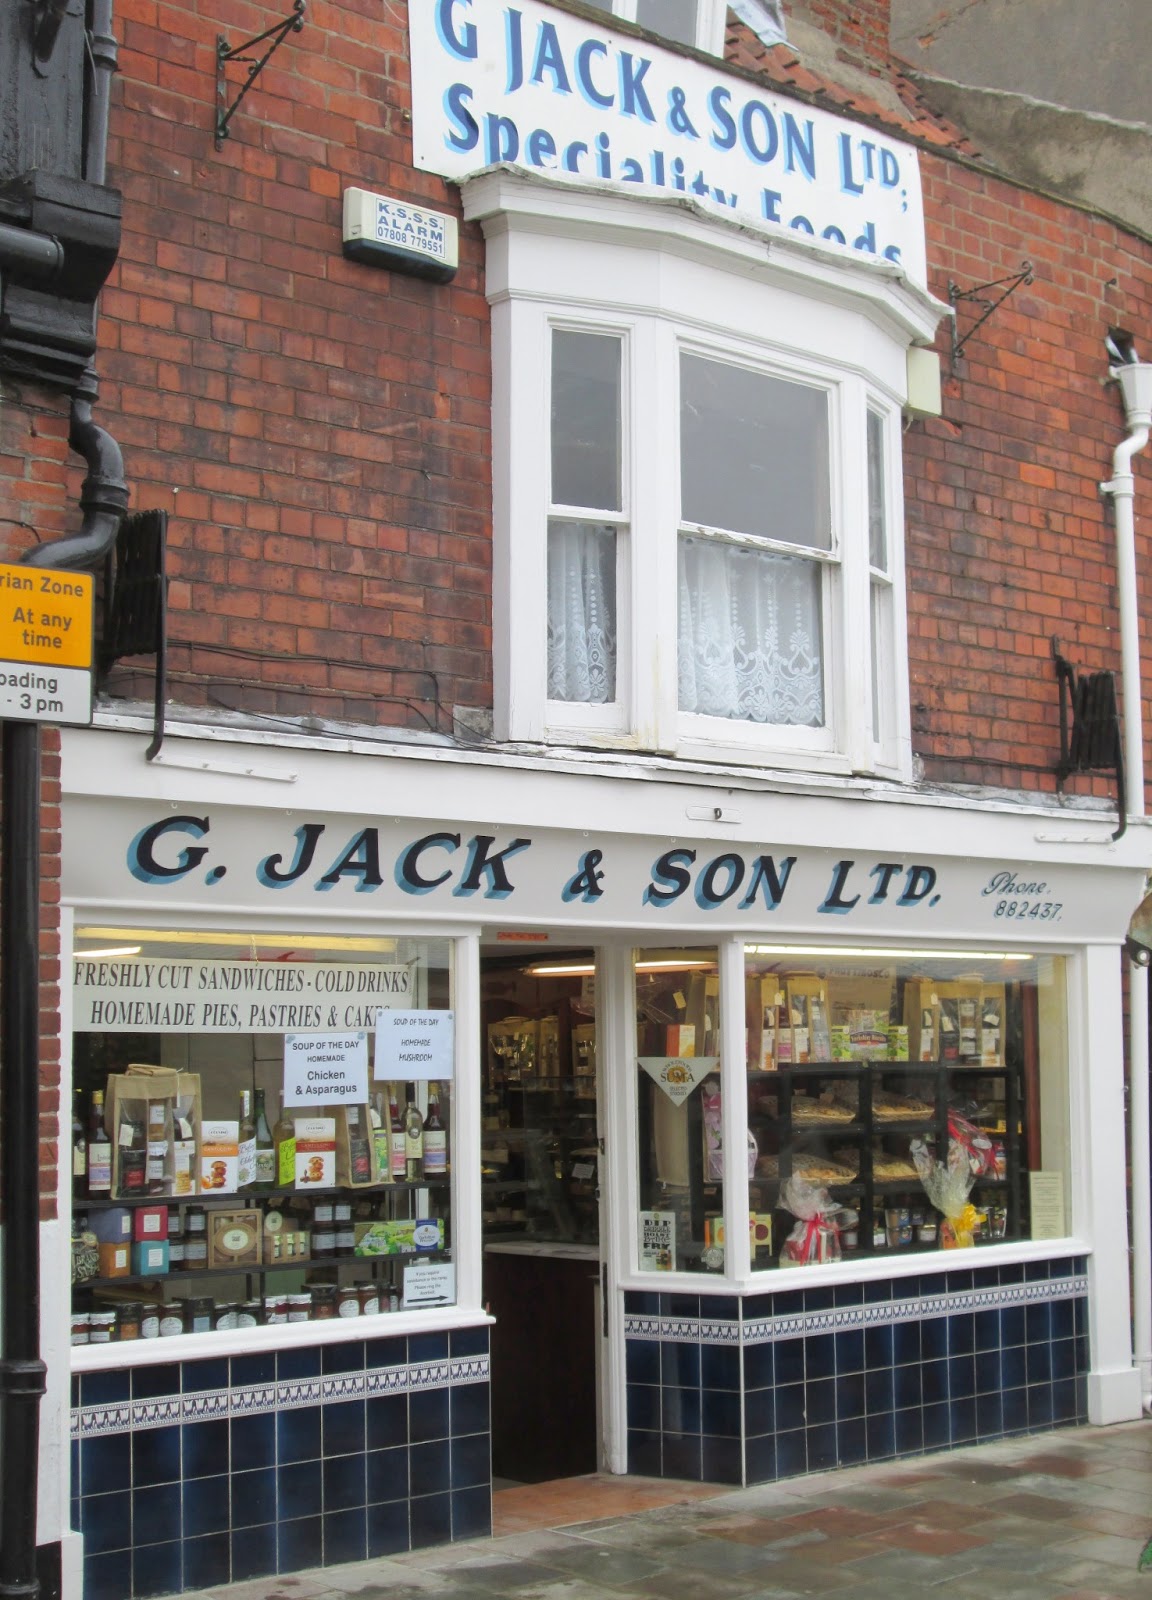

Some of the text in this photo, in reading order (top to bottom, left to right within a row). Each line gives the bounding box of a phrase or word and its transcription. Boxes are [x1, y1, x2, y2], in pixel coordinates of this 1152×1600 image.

[435, 0, 478, 62] G
[503, 7, 657, 124] JACK
[667, 86, 700, 139] &
[708, 85, 817, 183] SON
[378, 202, 443, 230] K.S.S.S.
[377, 226, 443, 254] 07808 779551
[378, 216, 443, 242] ALARM
[40, 576, 84, 597] Zone
[13, 607, 72, 632] At any
[22, 629, 63, 649] time
[127, 815, 942, 915] G. JACK & SON LTD.
[73, 962, 155, 988] FRESHLY
[158, 965, 193, 989] CUT
[198, 966, 305, 992] SANDWICHES
[315, 970, 355, 993] COLD
[356, 971, 409, 993] DRINKS
[90, 1001, 390, 1031] HOMEMADE PIES, PASTRIES & CAK
[292, 1041, 360, 1051] SOUP OF THE DAY
[307, 1054, 346, 1063] HOMEMADE
[398, 1053, 433, 1062] MUSHROOM
[307, 1070, 346, 1081] Chicken
[295, 1084, 358, 1097] & Asparagus
